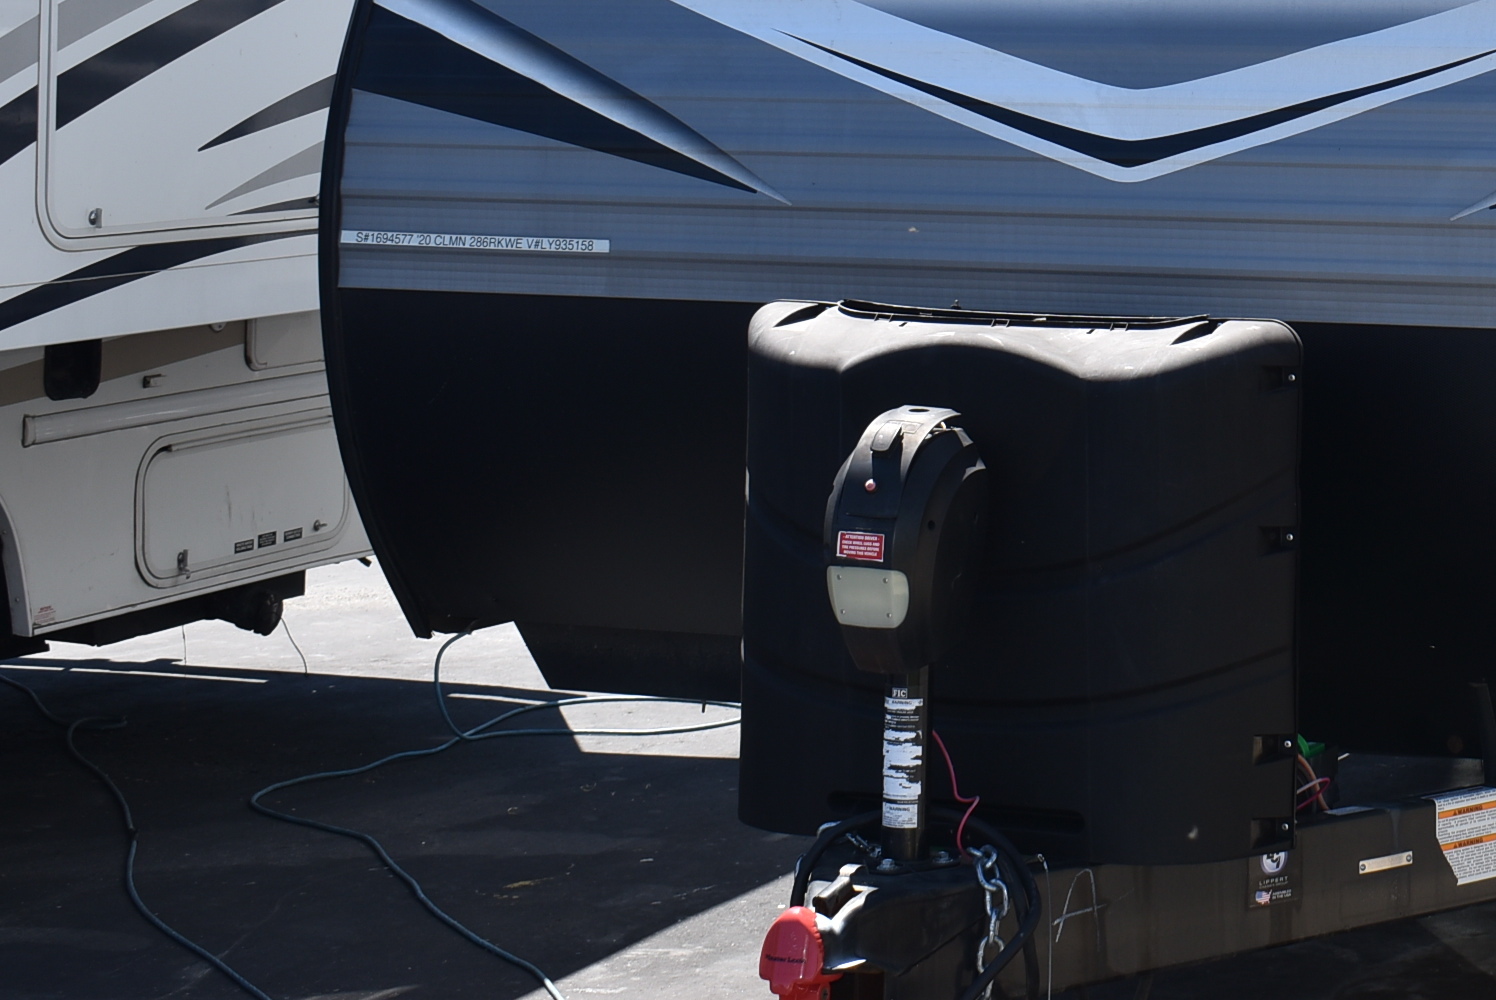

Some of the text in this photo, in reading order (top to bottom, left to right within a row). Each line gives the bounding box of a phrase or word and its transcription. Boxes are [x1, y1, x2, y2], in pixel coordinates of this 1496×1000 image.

[355, 231, 414, 245] S#1694577
[434, 235, 466, 247] CLMN
[469, 236, 523, 249] 286RKWE
[526, 238, 594, 251] V#LY935158
[1457, 804, 1483, 814] WARNING
[1457, 837, 1484, 848] WARNING
